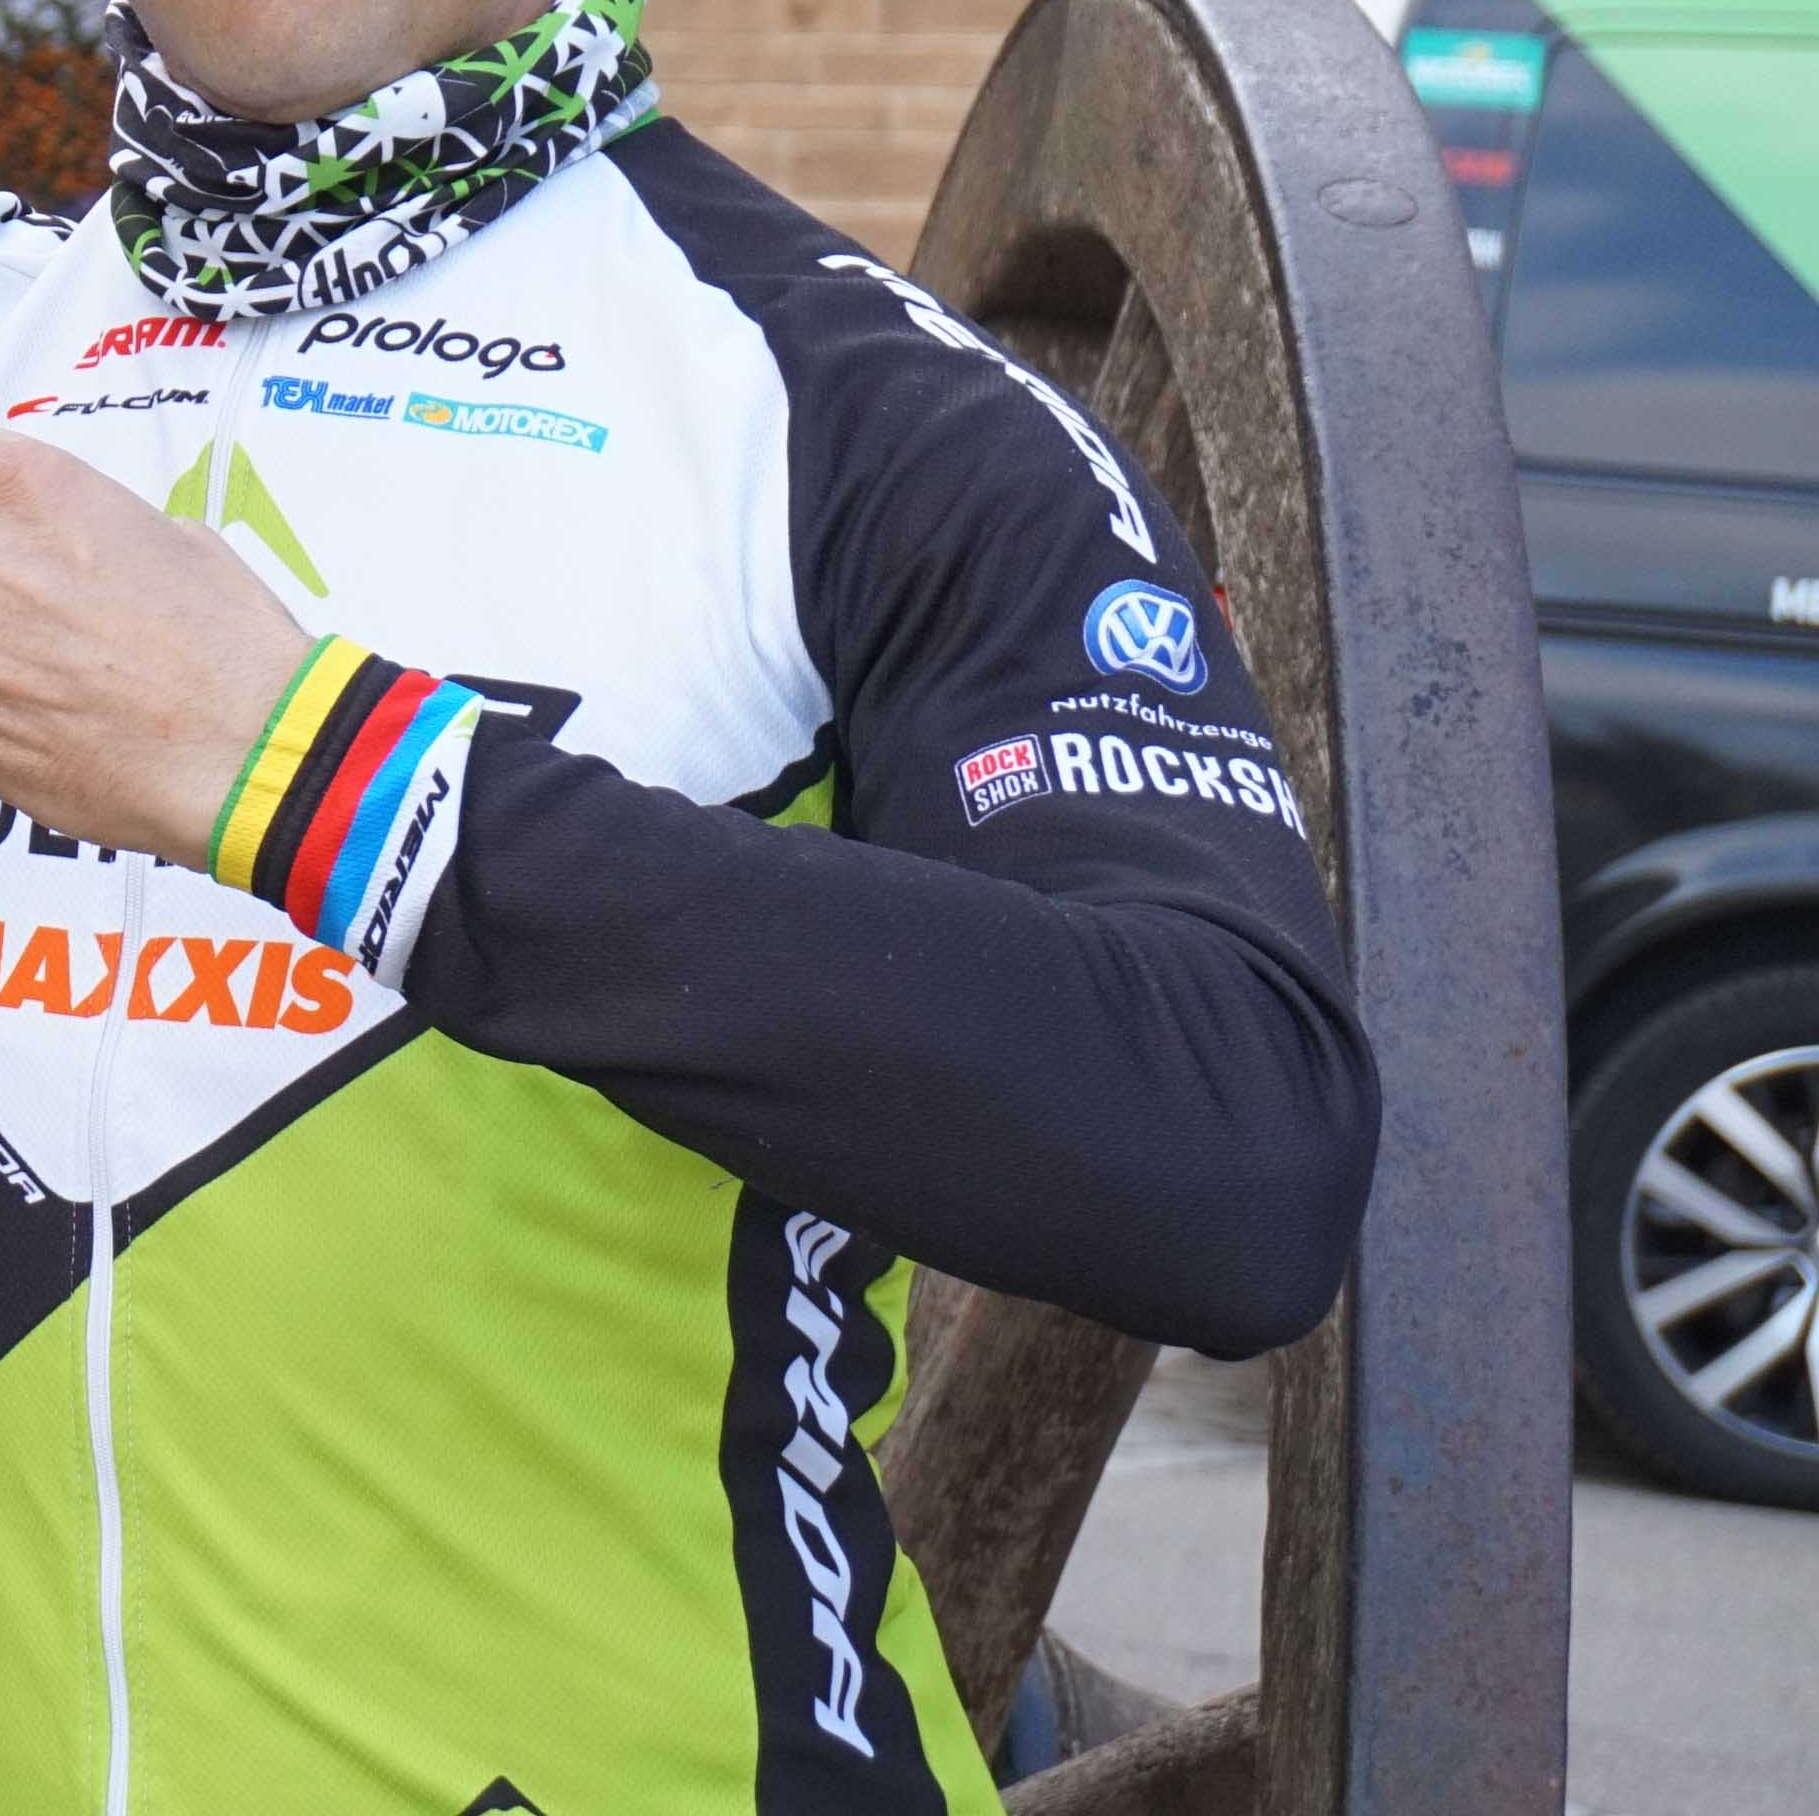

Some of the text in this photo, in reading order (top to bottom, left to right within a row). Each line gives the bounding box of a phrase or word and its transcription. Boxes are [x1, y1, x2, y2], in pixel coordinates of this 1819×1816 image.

[297, 312, 566, 380] prologo
[326, 393, 396, 420] market
[452, 406, 599, 450] MOTOREX
[1049, 692, 1274, 751] Nutzfahrzeuge
[966, 743, 1032, 785] ROCK
[973, 771, 1039, 813] SHOX
